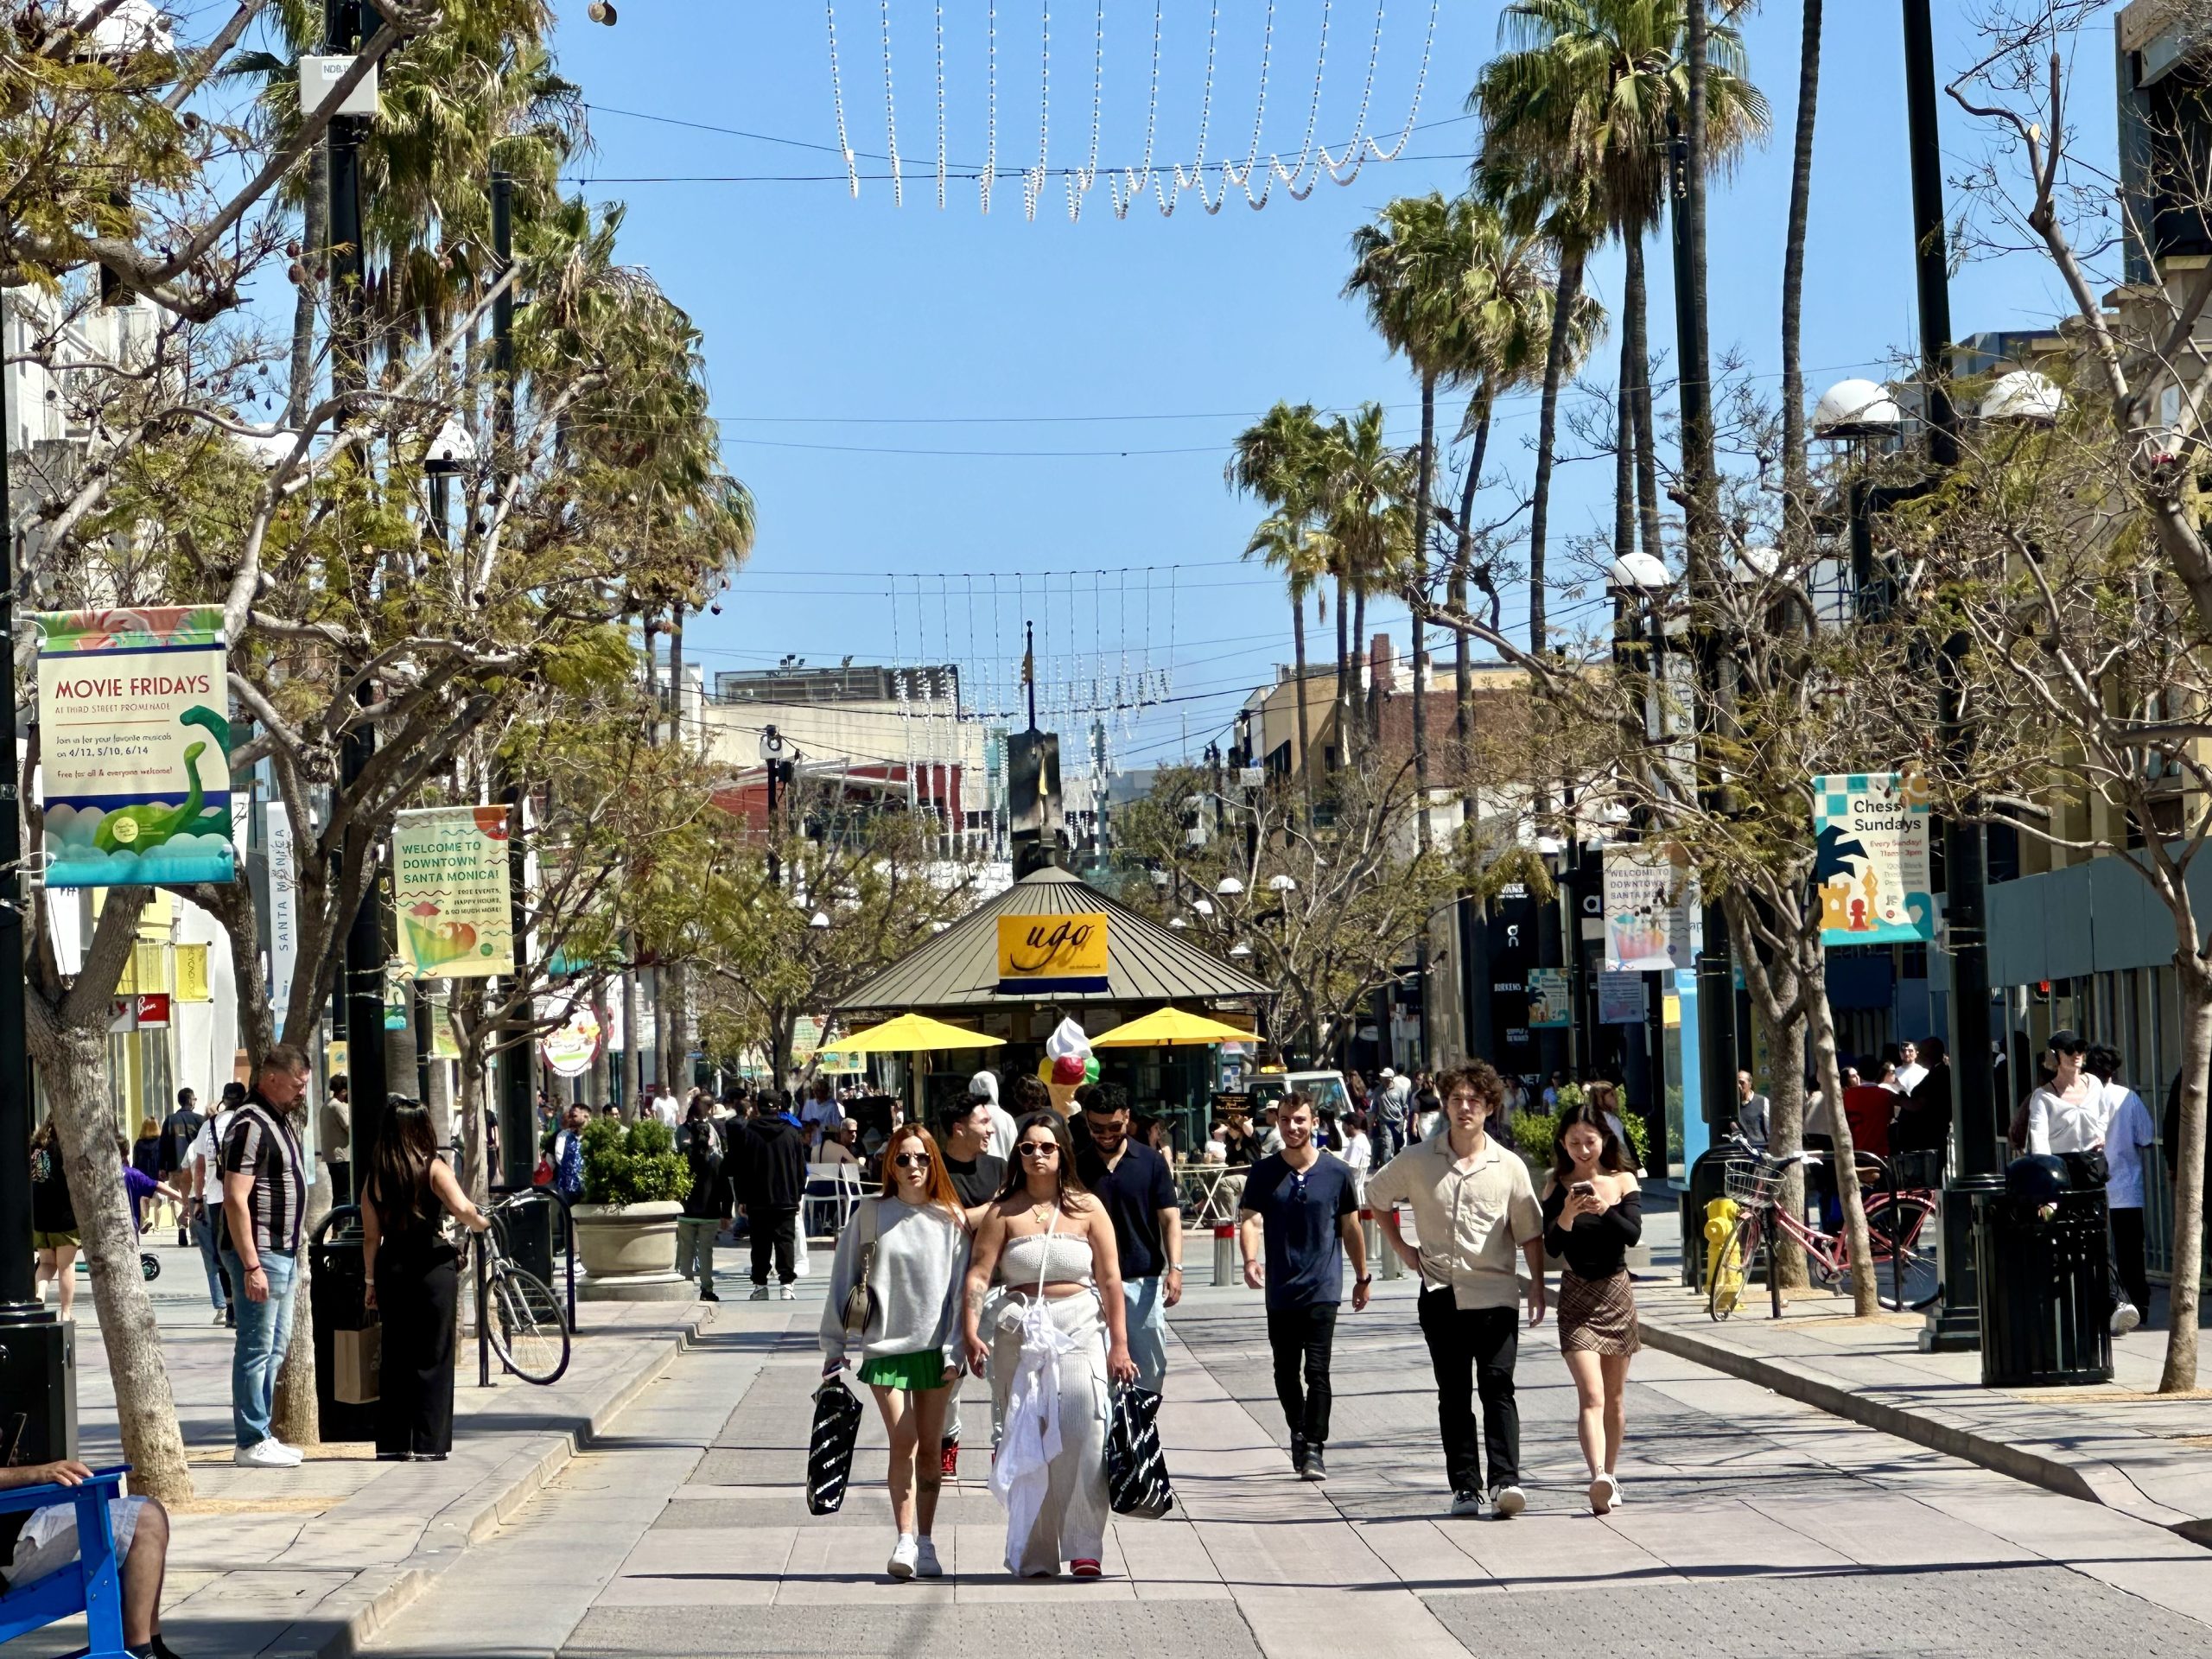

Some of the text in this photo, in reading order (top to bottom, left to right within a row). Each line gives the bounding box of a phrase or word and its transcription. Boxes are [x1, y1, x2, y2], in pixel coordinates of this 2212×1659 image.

[55, 675, 210, 699] MOVIE FRIDAYS
[67, 705, 89, 714] THIRD
[92, 704, 118, 714] STREET
[121, 702, 170, 712] PROMENADE
[56, 735, 71, 745] Join
[95, 736, 111, 745] your
[113, 733, 141, 743] favorite
[143, 732, 172, 741] musicals
[69, 747, 94, 757] 4/12,
[98, 746, 124, 756] 5/10,
[125, 745, 149, 755] 6/14
[57, 770, 73, 779] Free
[106, 769, 138, 778] everyone
[140, 766, 173, 775] welcome!
[1853, 799, 1902, 814] Chess
[1854, 817, 1922, 834] Sundays
[402, 841, 481, 855] WELCOME TO
[1870, 840, 1891, 849] Every
[403, 856, 477, 869] DOWNTOWN
[404, 869, 499, 884] SANTA MONICA!
[1611, 868, 1653, 878] WELCOME
[1611, 891, 1642, 899] SANTA
[278, 901, 289, 952] SANTA
[1010, 920, 1096, 972] ugo
